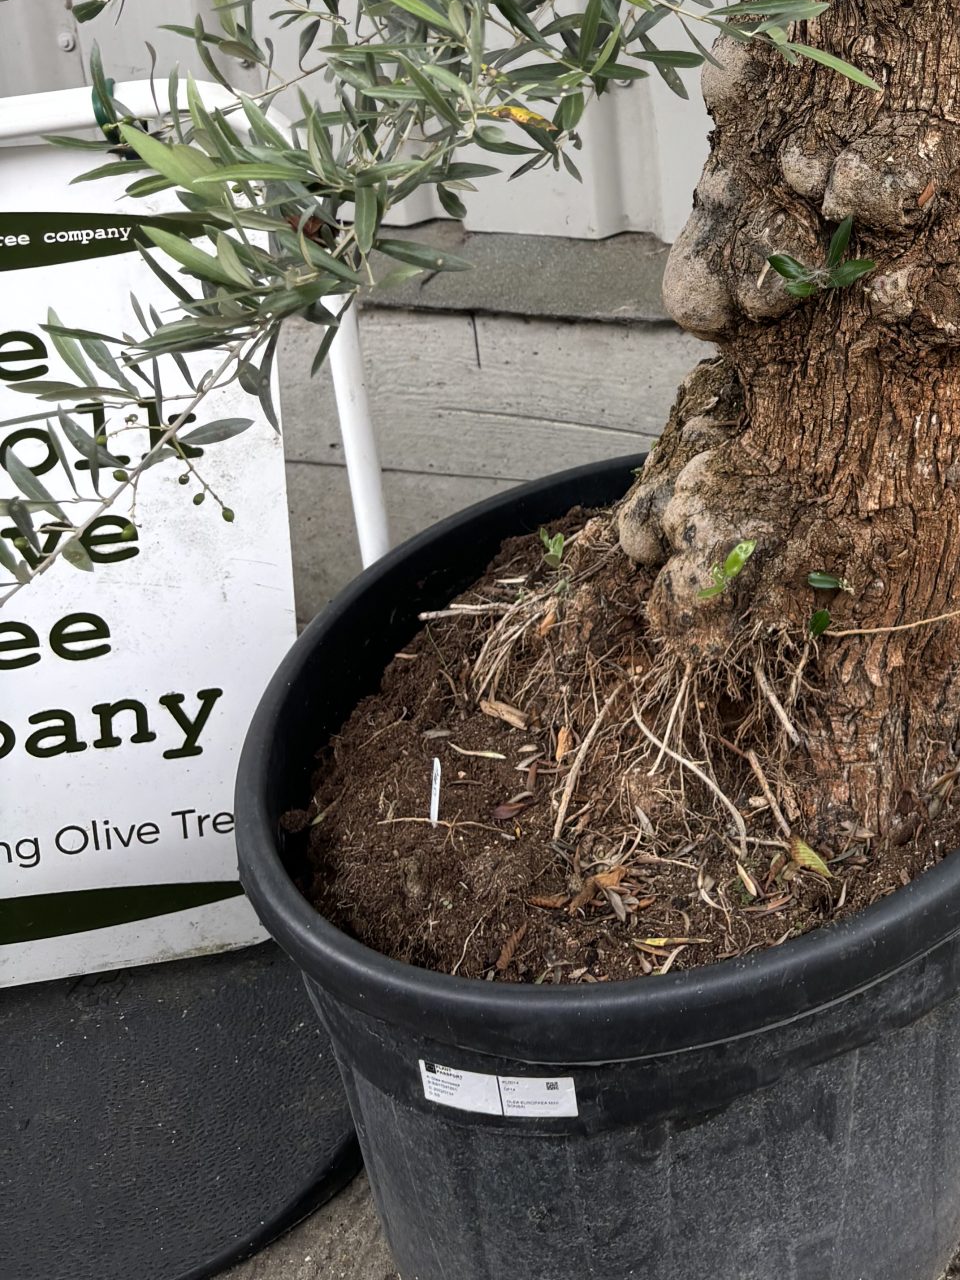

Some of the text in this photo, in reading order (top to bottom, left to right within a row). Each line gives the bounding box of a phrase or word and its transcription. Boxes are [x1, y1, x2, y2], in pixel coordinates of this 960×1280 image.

[44, 227, 132, 245] company
[0, 688, 223, 760] any
[55, 819, 160, 855] Olive
